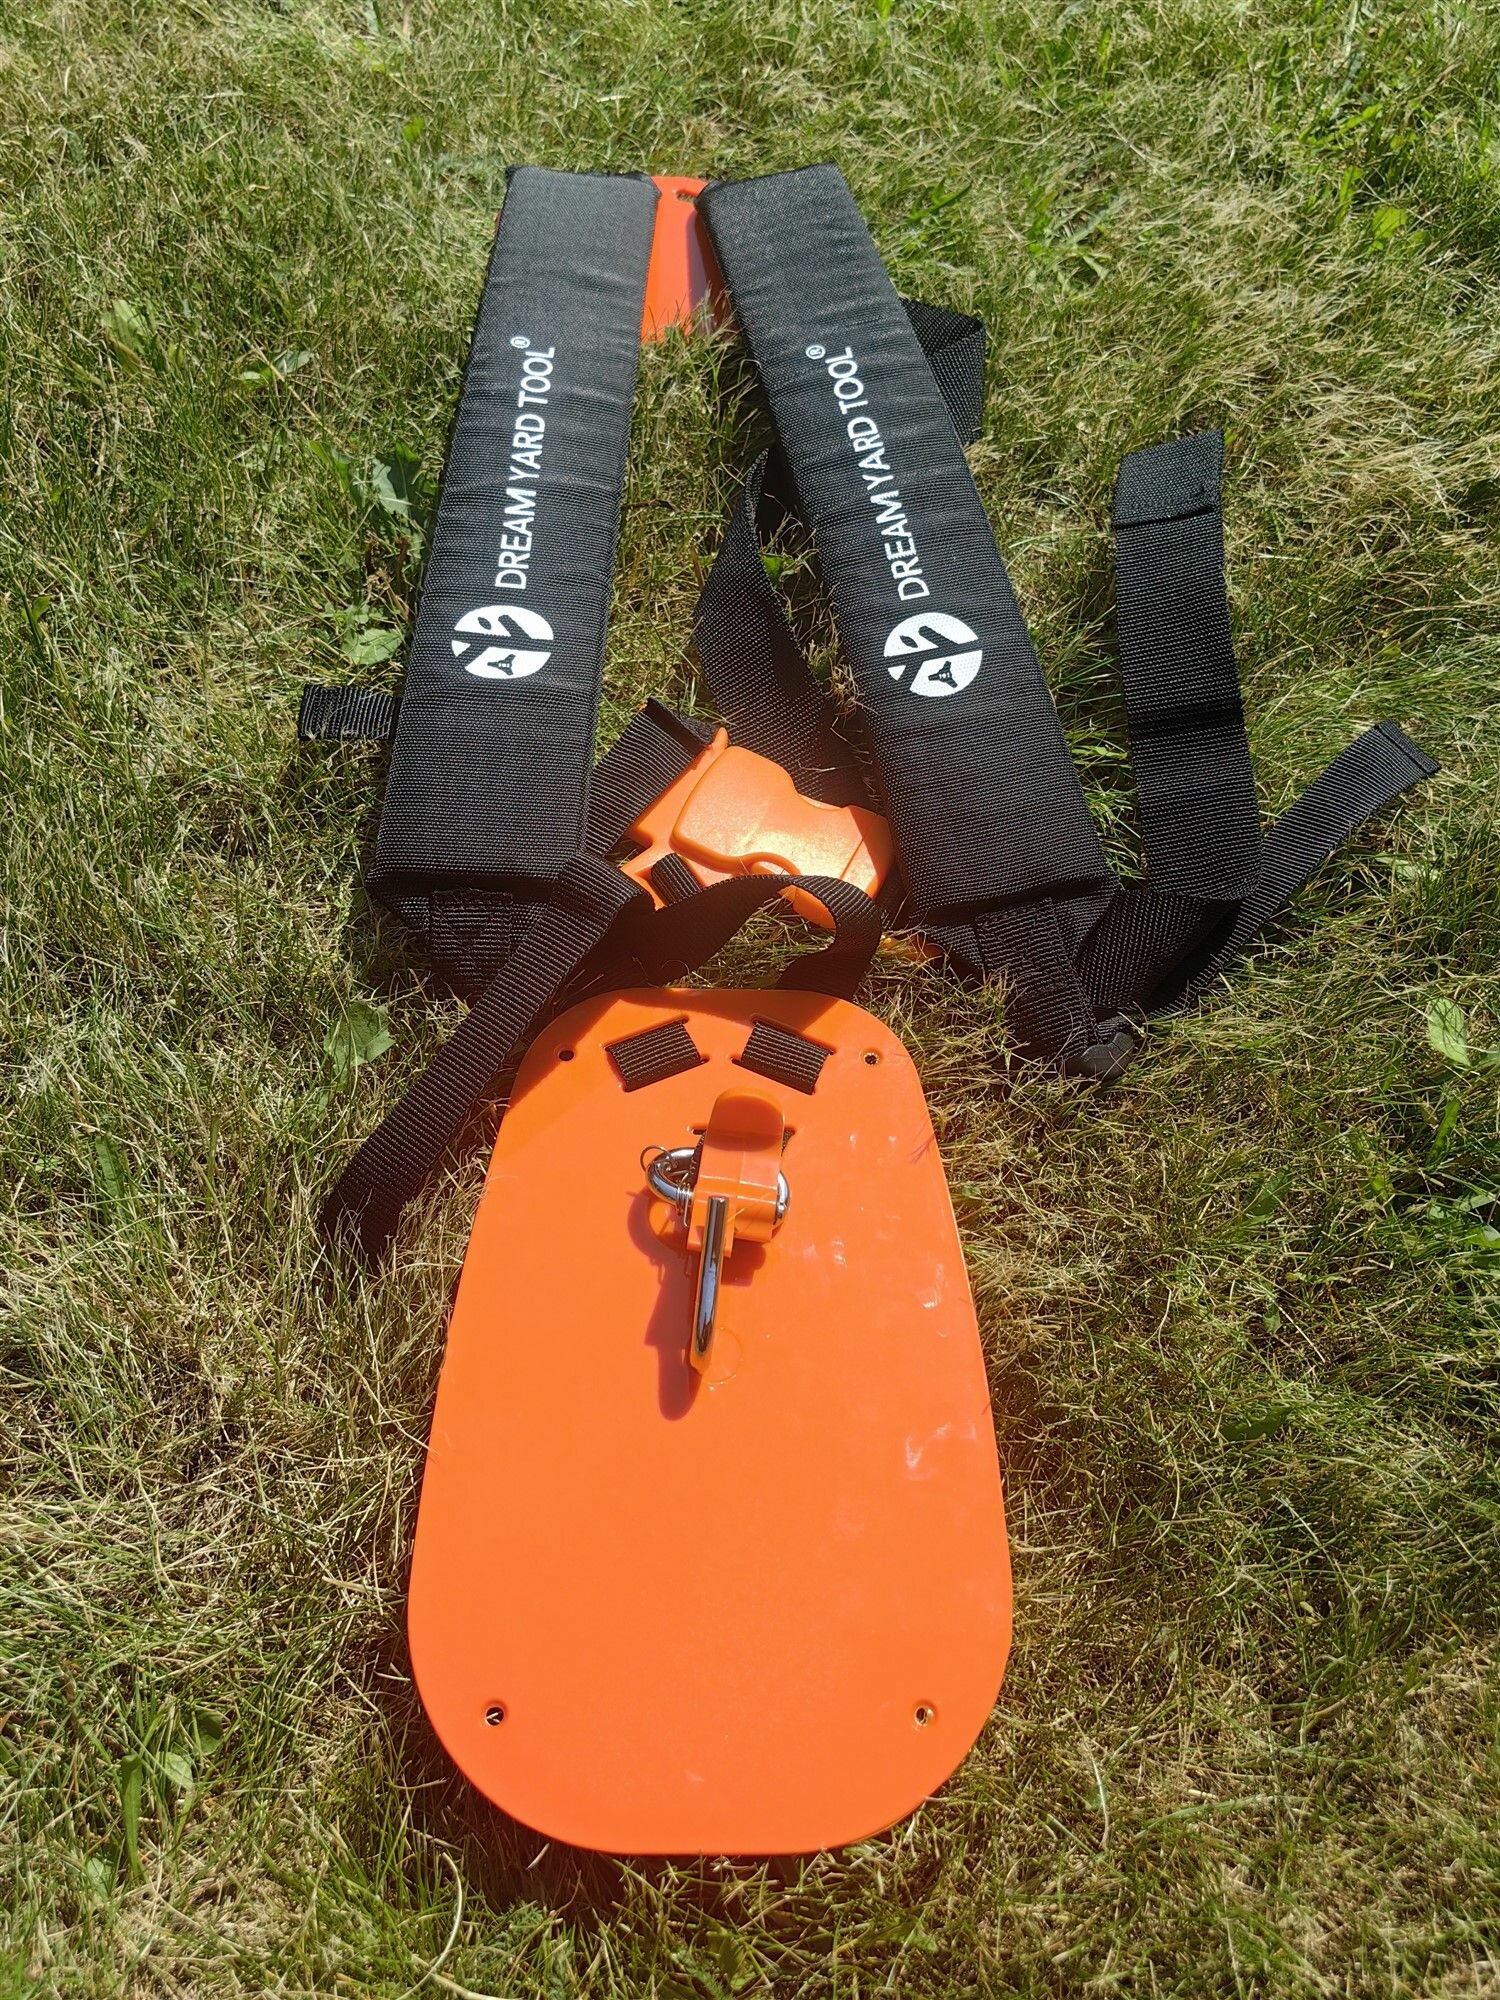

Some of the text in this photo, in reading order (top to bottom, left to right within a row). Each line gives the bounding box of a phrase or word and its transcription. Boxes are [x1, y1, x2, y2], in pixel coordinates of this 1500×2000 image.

[508, 413, 546, 481] YARD
[846, 415, 895, 491] YARD
[494, 488, 537, 590] DREAM
[869, 489, 931, 601] DREAM
